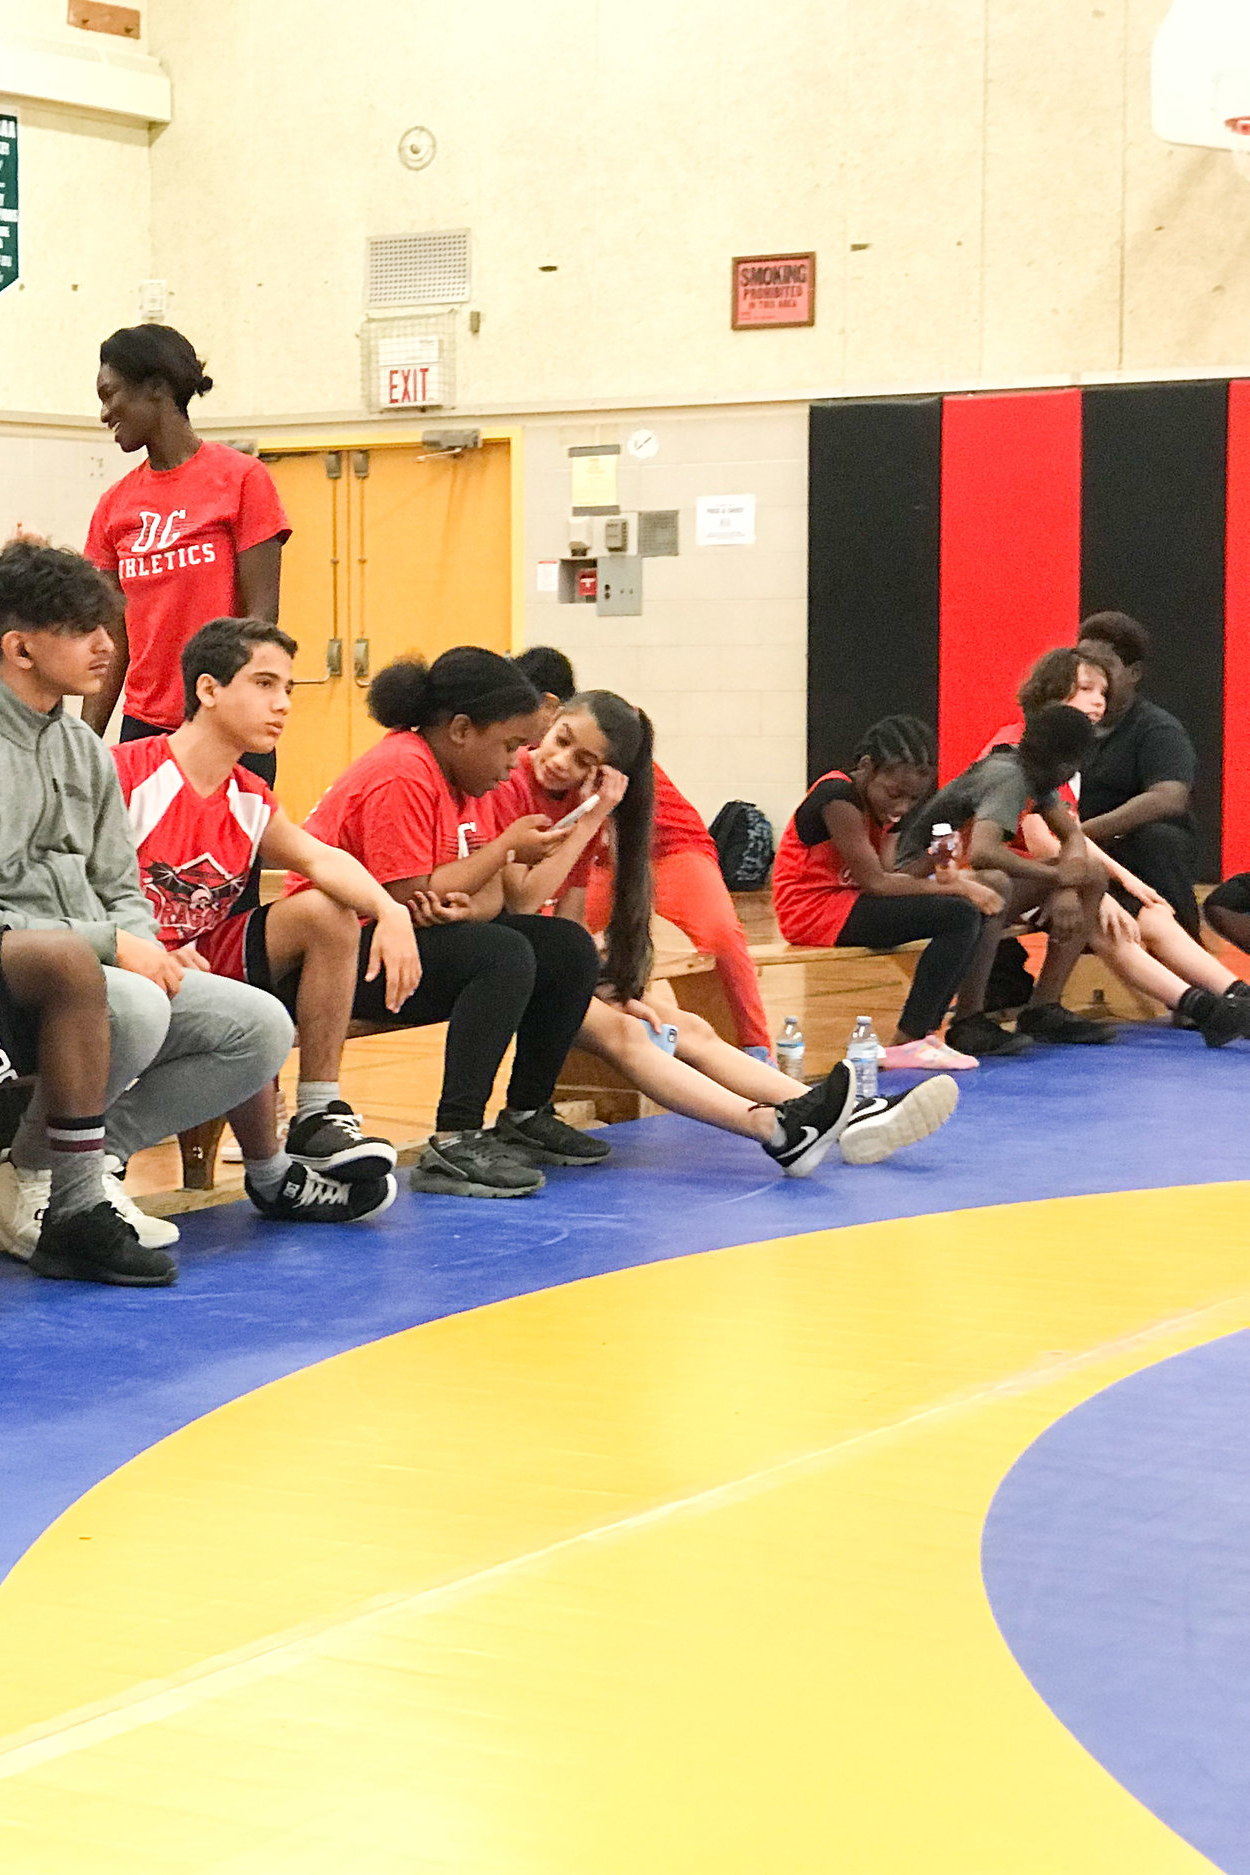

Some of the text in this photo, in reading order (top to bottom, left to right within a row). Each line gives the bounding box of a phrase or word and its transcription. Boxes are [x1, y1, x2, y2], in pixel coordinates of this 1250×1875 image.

[741, 264, 807, 287] SMOKING
[743, 285, 804, 300] PROHIBITED
[389, 367, 429, 404] EXIT
